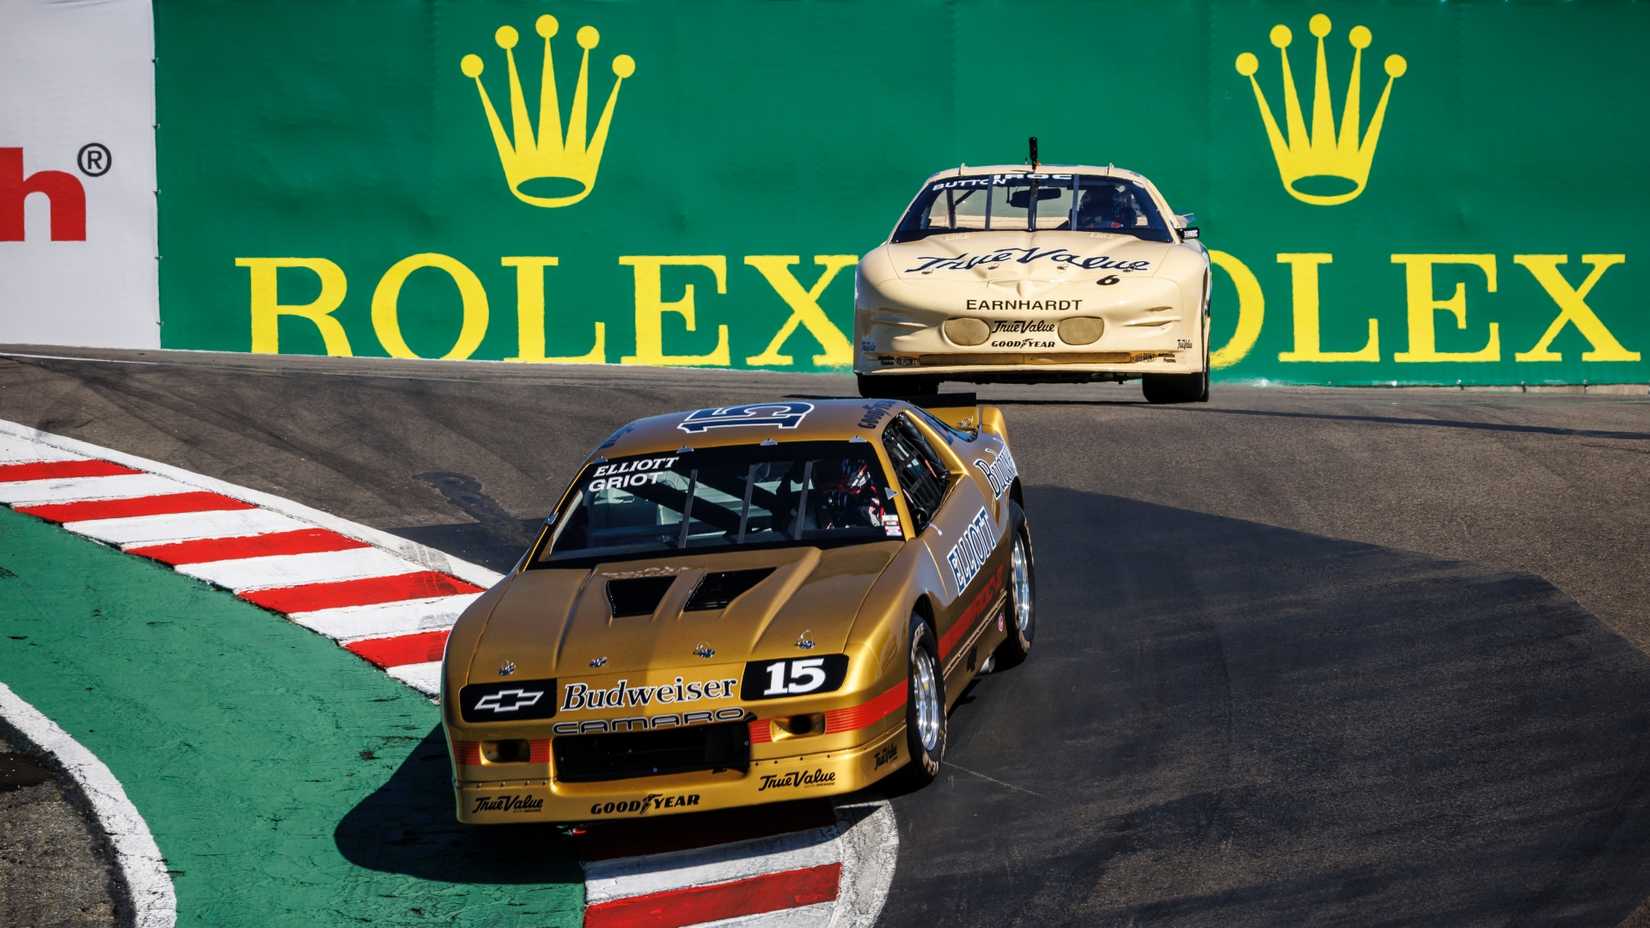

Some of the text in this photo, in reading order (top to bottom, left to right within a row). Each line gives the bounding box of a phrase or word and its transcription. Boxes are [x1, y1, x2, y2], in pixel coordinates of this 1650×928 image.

[932, 177, 1006, 191] BUTTON
[1096, 274, 1121, 286] 6
[234, 253, 859, 366] ROLEX
[966, 299, 1083, 311] EARNHARDT
[593, 457, 680, 478] ELLIOTT
[589, 472, 664, 493] GRIOT
[947, 505, 997, 596] ELLIOTT
[763, 658, 827, 696] 15
[560, 675, 738, 712] Budweiser
[552, 707, 746, 735] CAMARO
